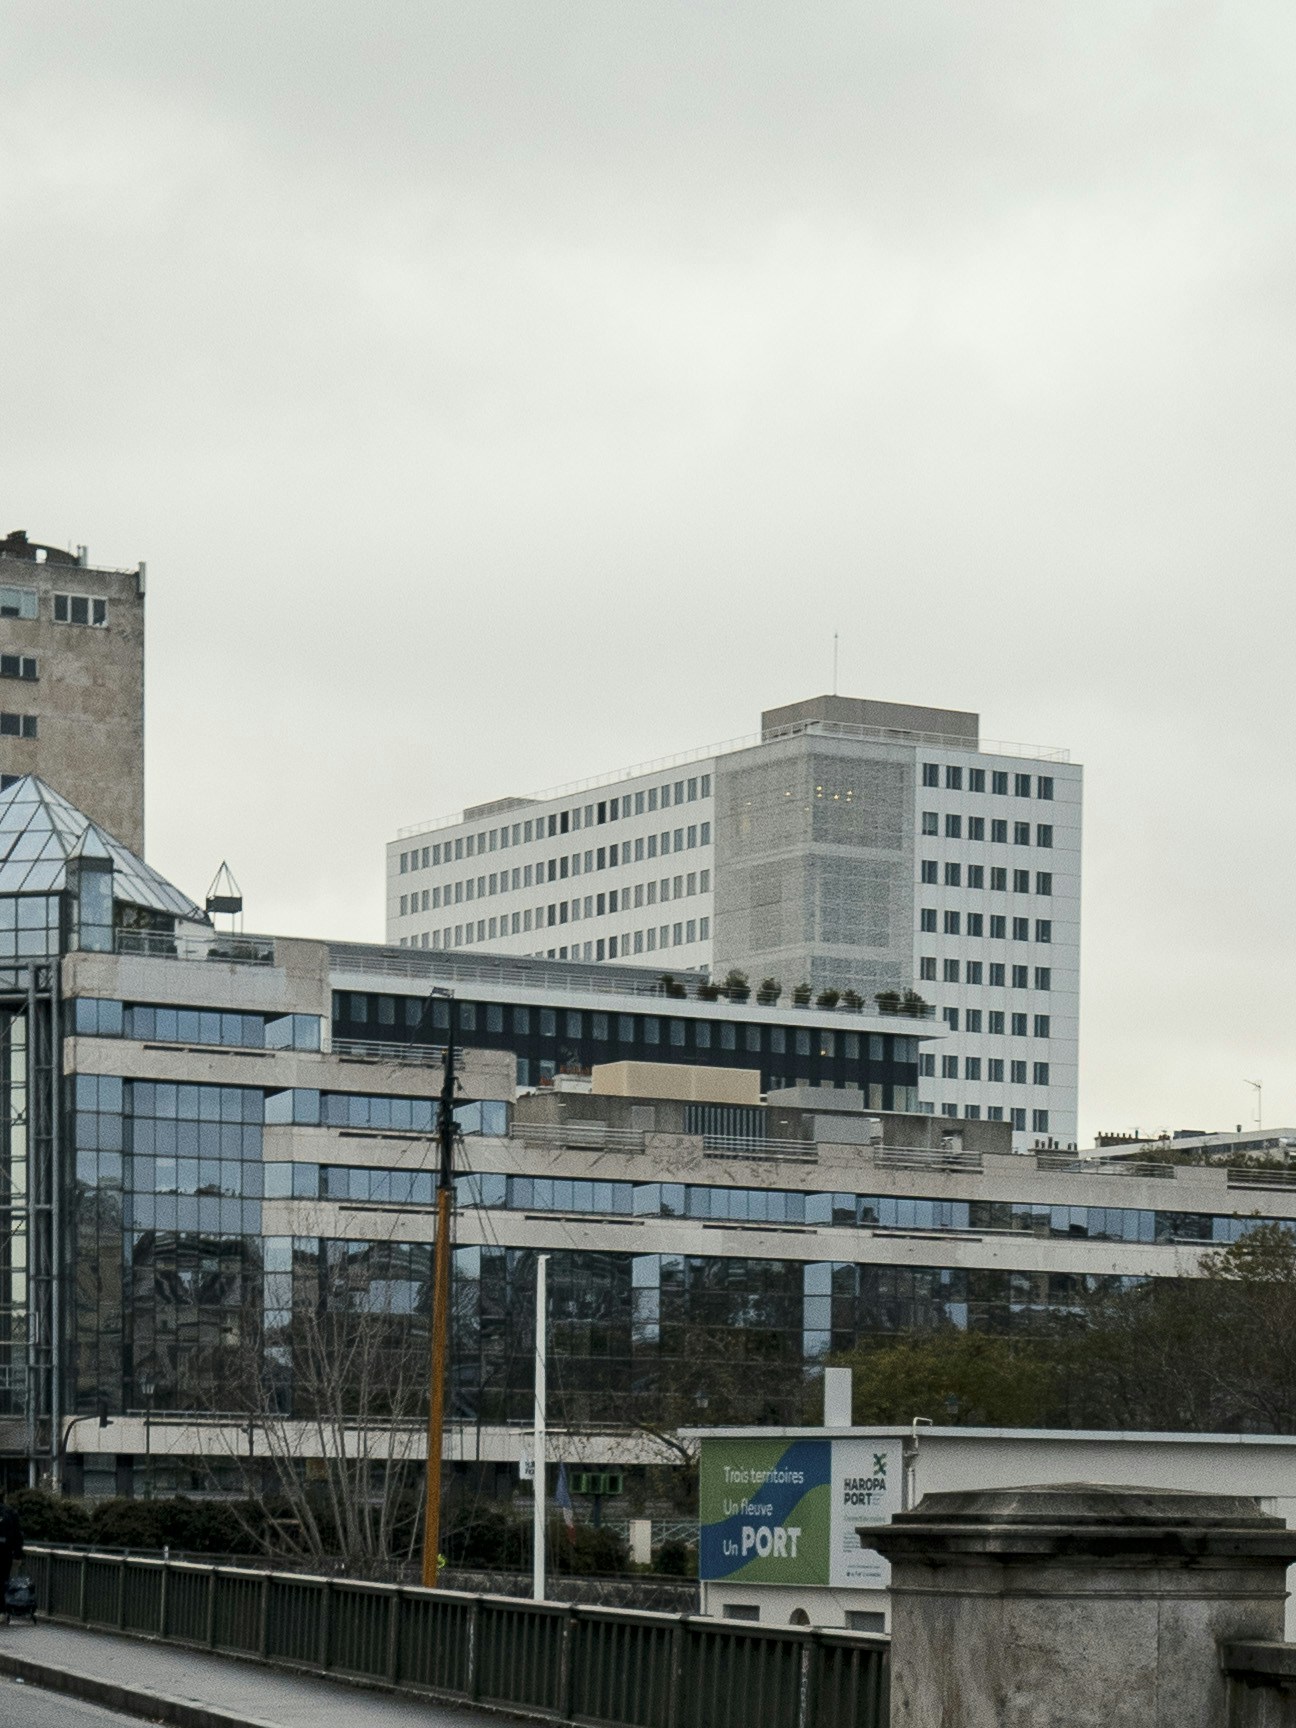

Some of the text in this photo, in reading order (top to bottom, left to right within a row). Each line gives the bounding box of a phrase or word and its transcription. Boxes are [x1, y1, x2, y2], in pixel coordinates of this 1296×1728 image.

[723, 1466, 804, 1484] Trois territoires
[844, 1478, 886, 1491] HAROPA
[723, 1497, 774, 1517] Un fleuve
[844, 1492, 872, 1505] PORT
[722, 1525, 802, 1558] Un PORT
